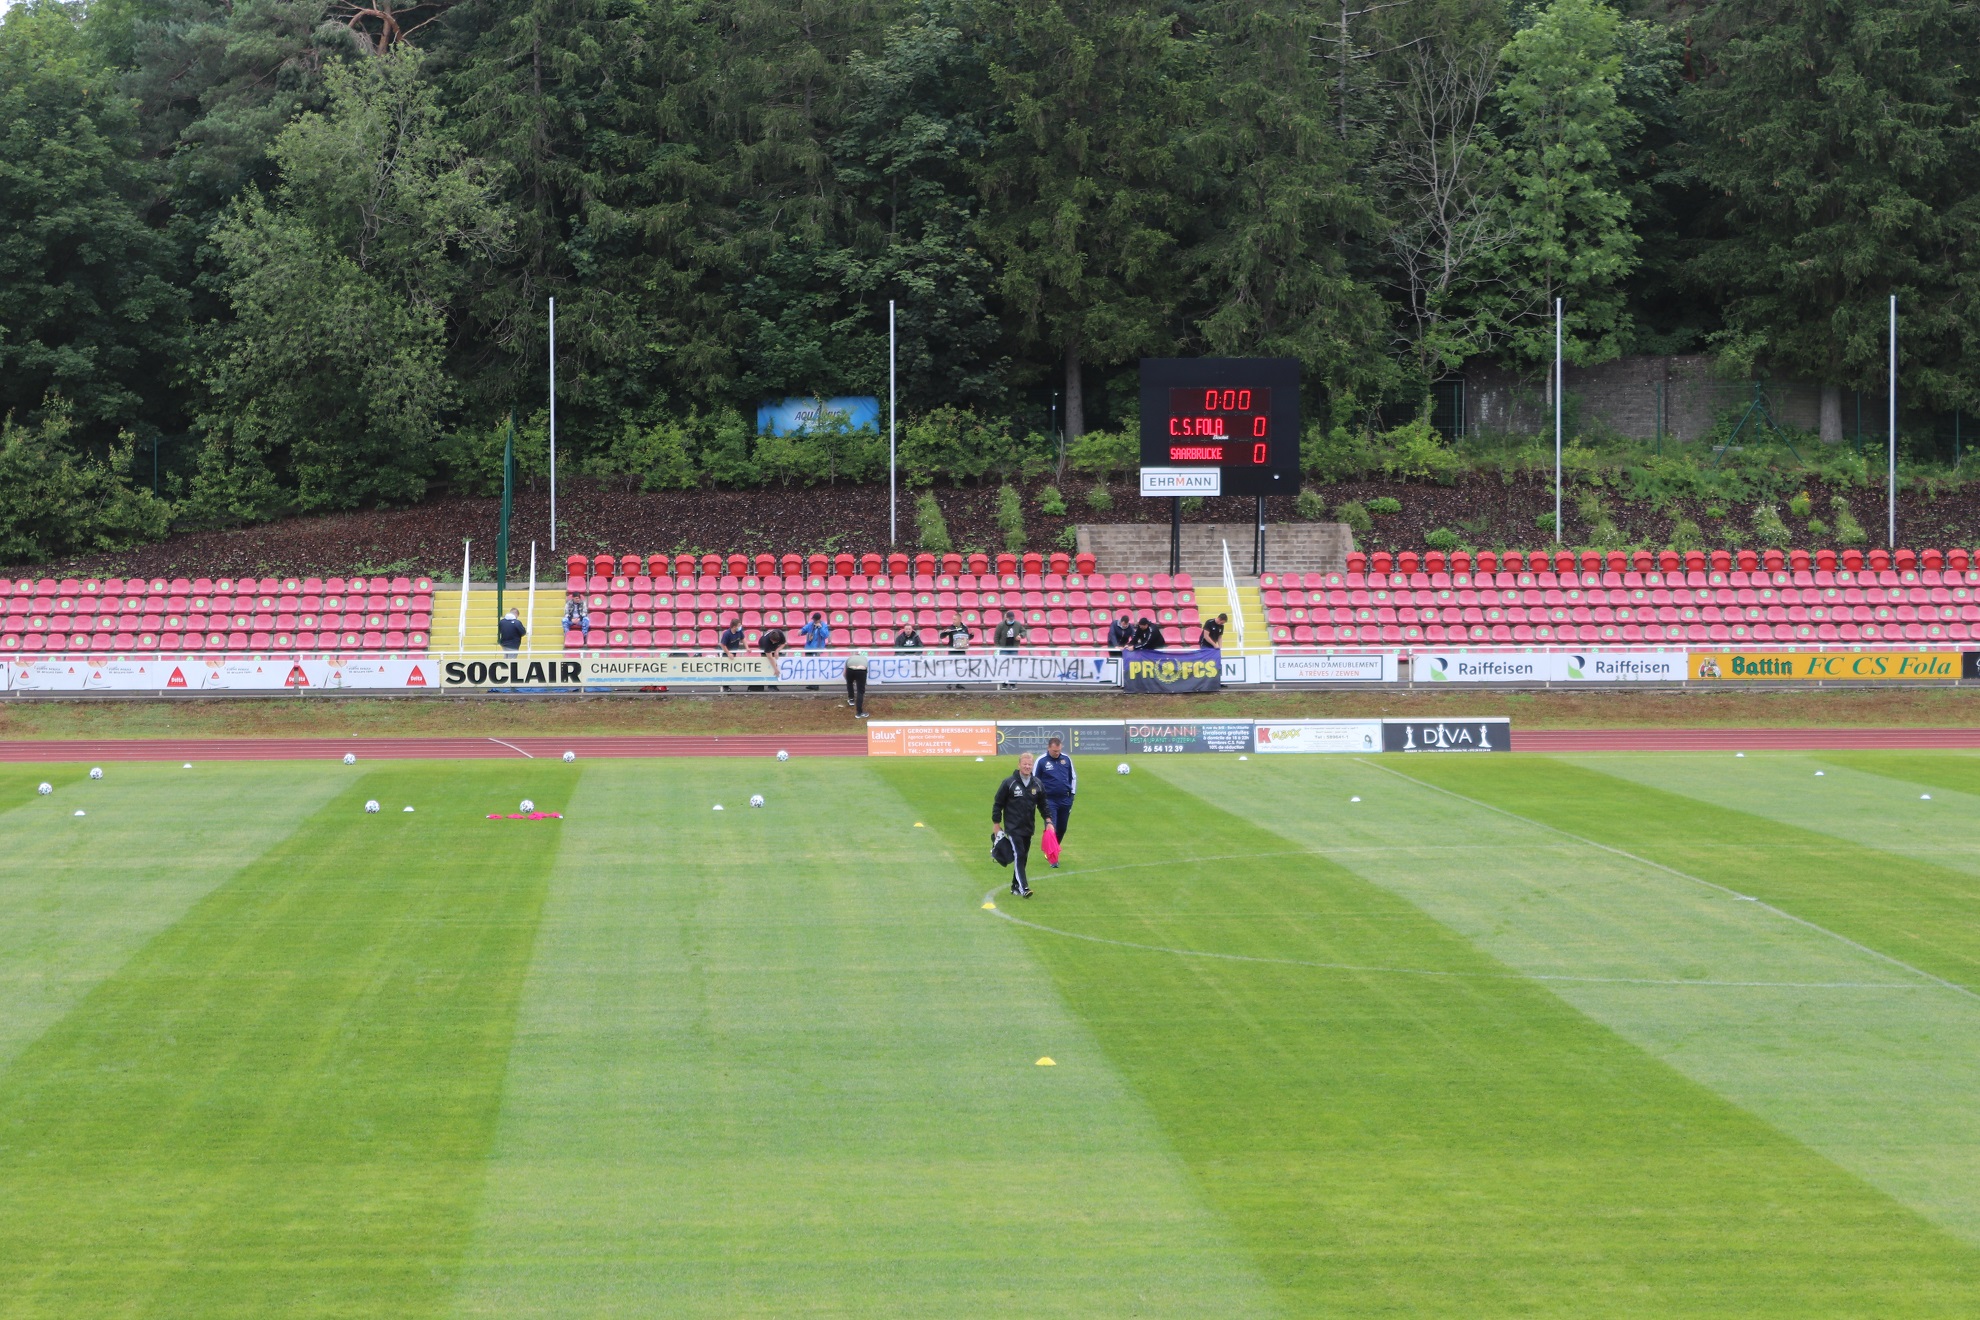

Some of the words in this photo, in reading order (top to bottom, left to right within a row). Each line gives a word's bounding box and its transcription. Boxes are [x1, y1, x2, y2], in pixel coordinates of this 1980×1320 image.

[1205, 390, 1251, 411] 0:00
[1253, 416, 1267, 437] 0
[1170, 447, 1223, 460] SAARBRUCKE
[1253, 443, 1267, 464] 0
[1149, 477, 1212, 487] EHRMANN
[445, 661, 582, 685] SOCLAIR
[591, 663, 668, 674] CHAUFFAGE
[1458, 661, 1533, 675] Raiffeisen
[1595, 660, 1670, 674] Raiffeisen
[1731, 656, 1792, 676] Battin
[1806, 656, 1845, 675] FC
[1852, 656, 1889, 675] CS
[1897, 656, 1952, 675] Fola
[871, 730, 896, 740] lalux
[1129, 725, 1197, 738] DOMANNI
[1423, 725, 1472, 745] DIVA
